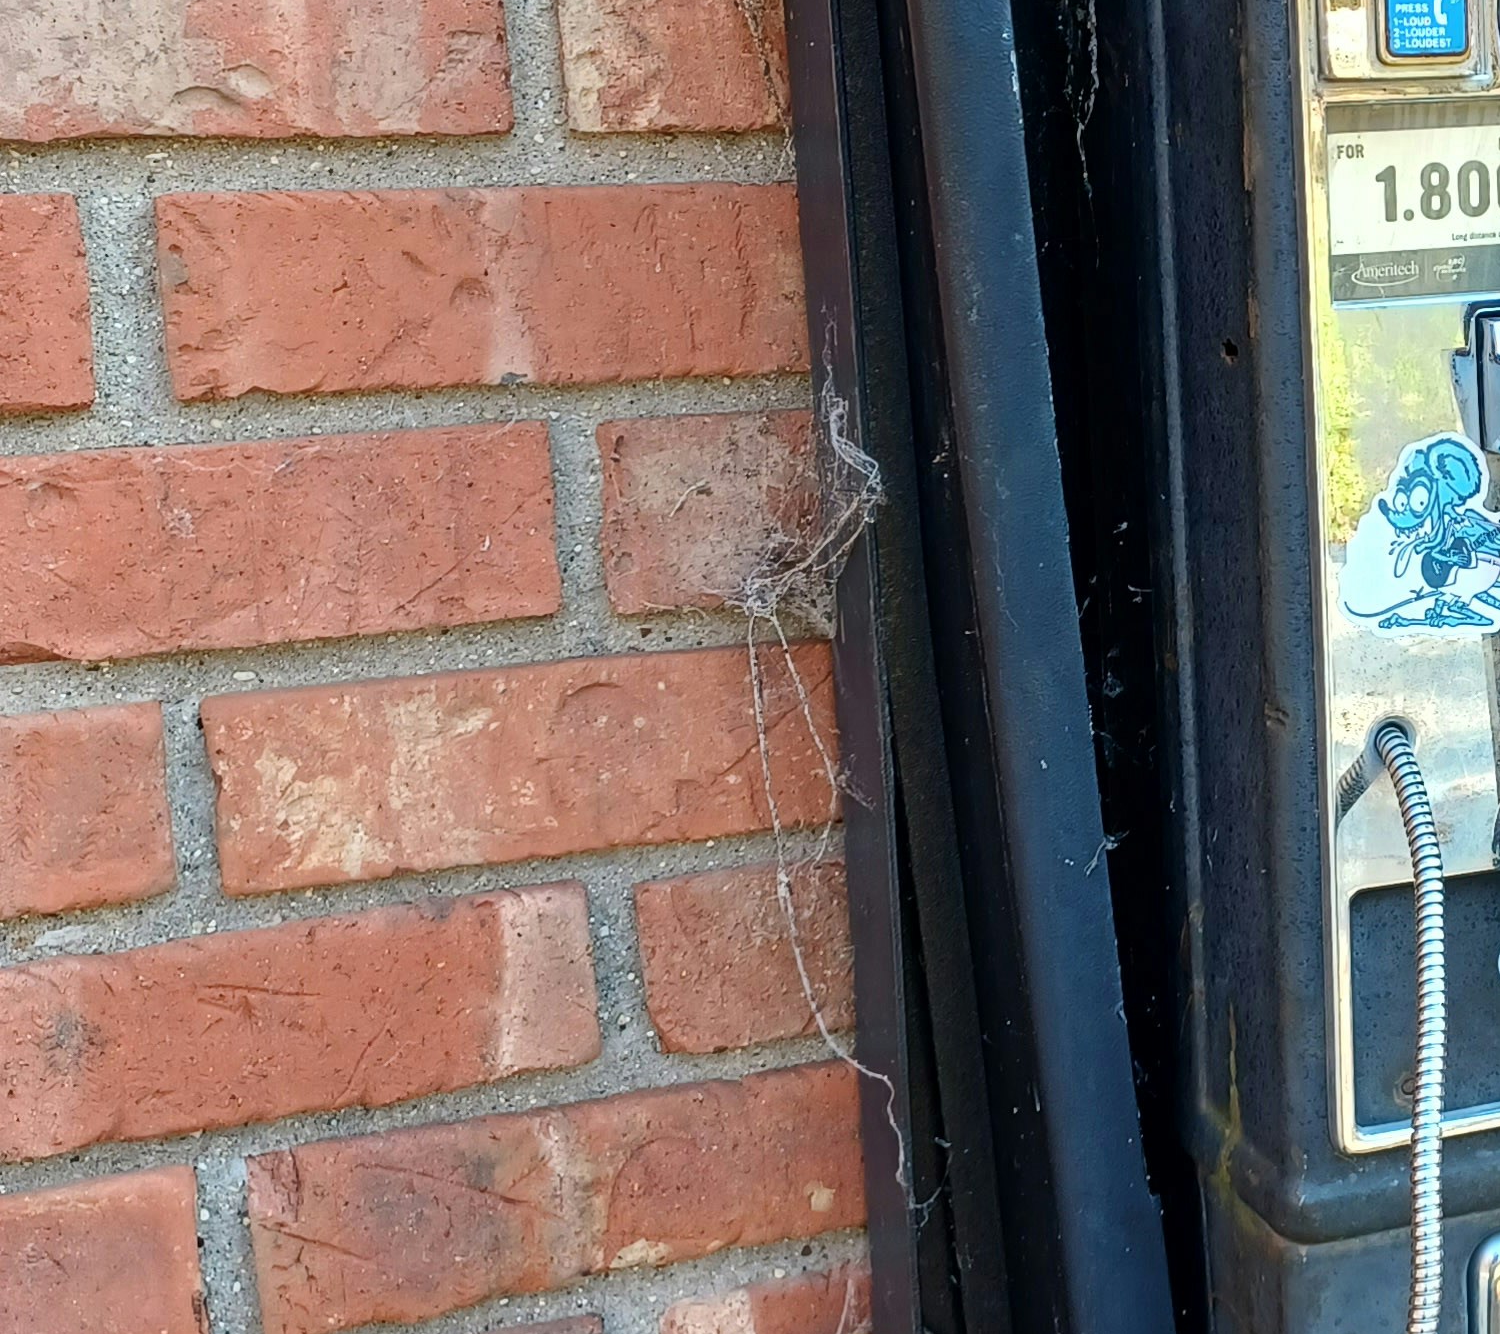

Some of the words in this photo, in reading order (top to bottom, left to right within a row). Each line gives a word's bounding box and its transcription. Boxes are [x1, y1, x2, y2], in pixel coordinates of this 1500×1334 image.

[1395, 3, 1430, 14] PRESS
[1393, 16, 1432, 27] 1-LOUD
[1393, 27, 1447, 38] 2-LOUDER
[1393, 38, 1452, 49] 3-LOUDEST
[1337, 144, 1365, 159] FOR
[1356, 259, 1420, 278] Ameritech
